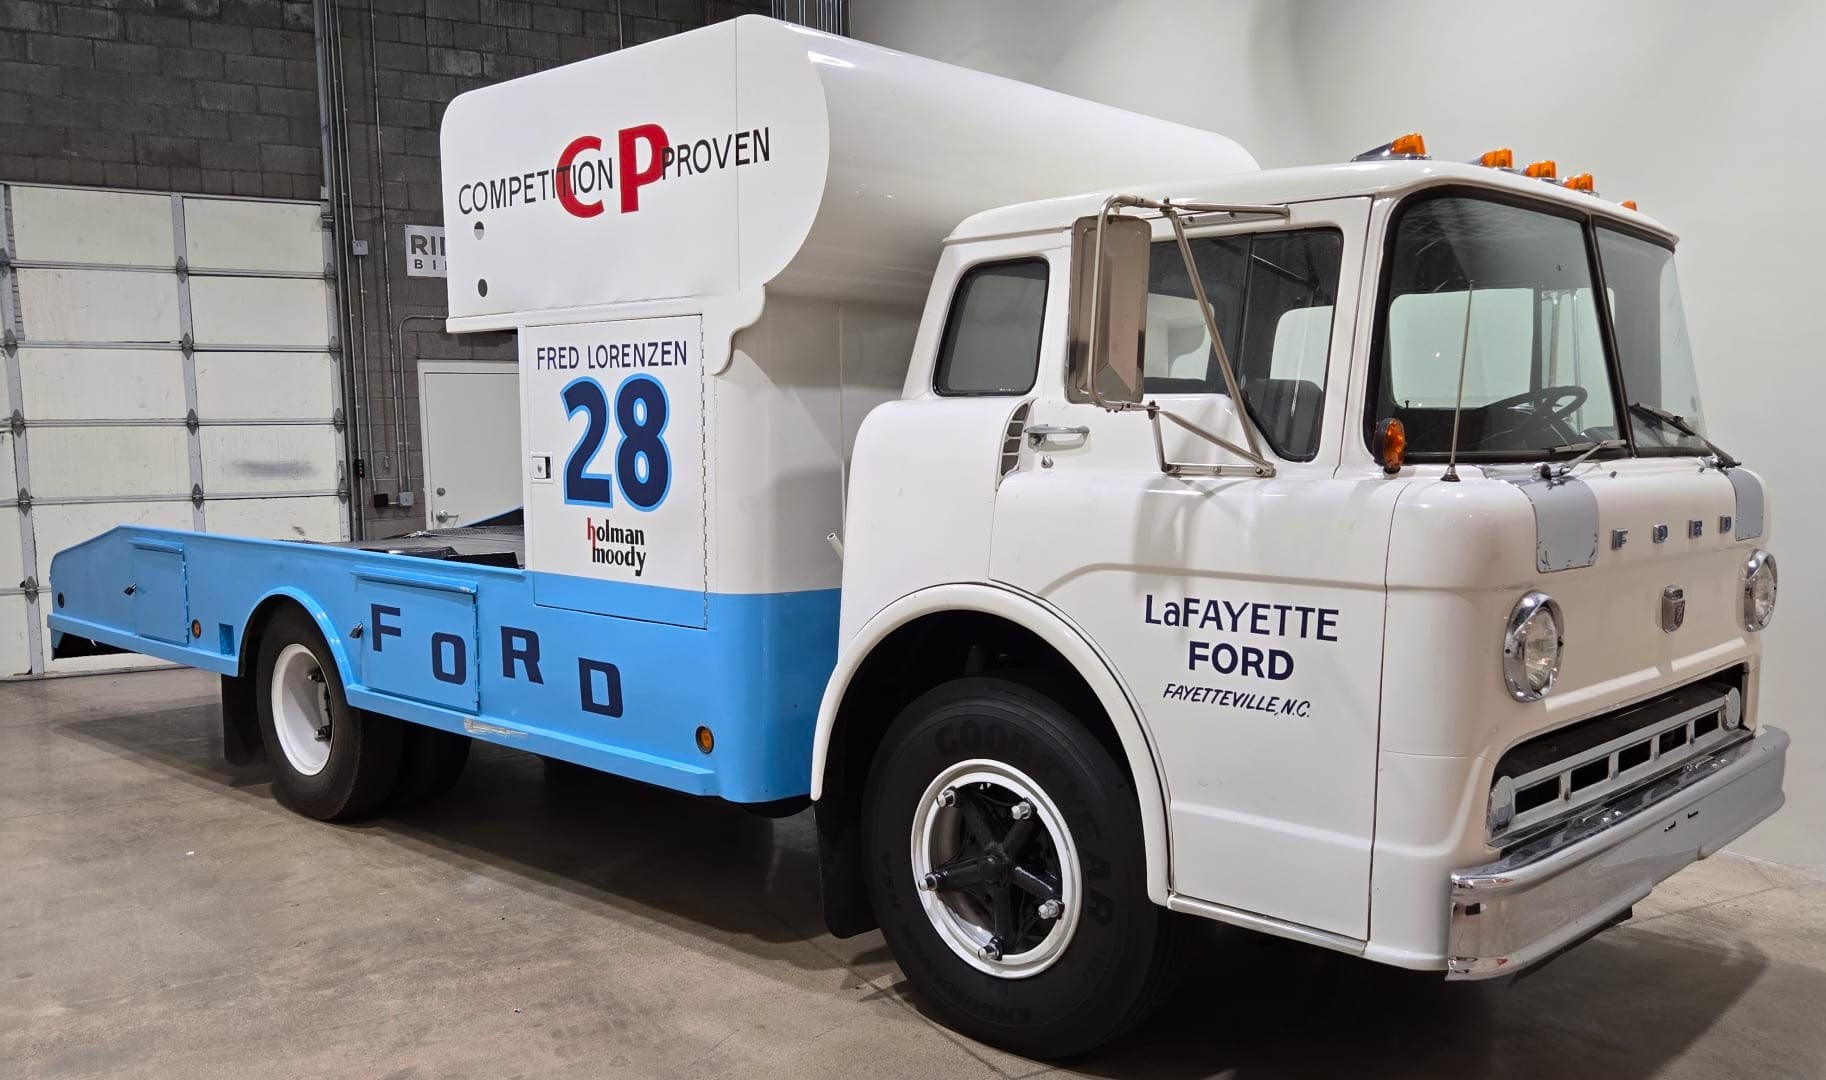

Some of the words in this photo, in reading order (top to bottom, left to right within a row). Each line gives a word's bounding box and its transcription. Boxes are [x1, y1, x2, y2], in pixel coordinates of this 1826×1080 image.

[458, 157, 614, 215] COMPETITION
[662, 126, 770, 180] PROVEN
[414, 258, 447, 271] BI
[536, 346, 580, 371] FRED
[587, 340, 688, 369] LORENZEN
[560, 373, 673, 512] 28
[587, 517, 646, 547] holman
[1611, 514, 1733, 551] FORD
[592, 546, 647, 577] moody
[1144, 594, 1340, 642] LaFAYETTE
[370, 603, 624, 719] FORD
[1188, 640, 1295, 681] FORD
